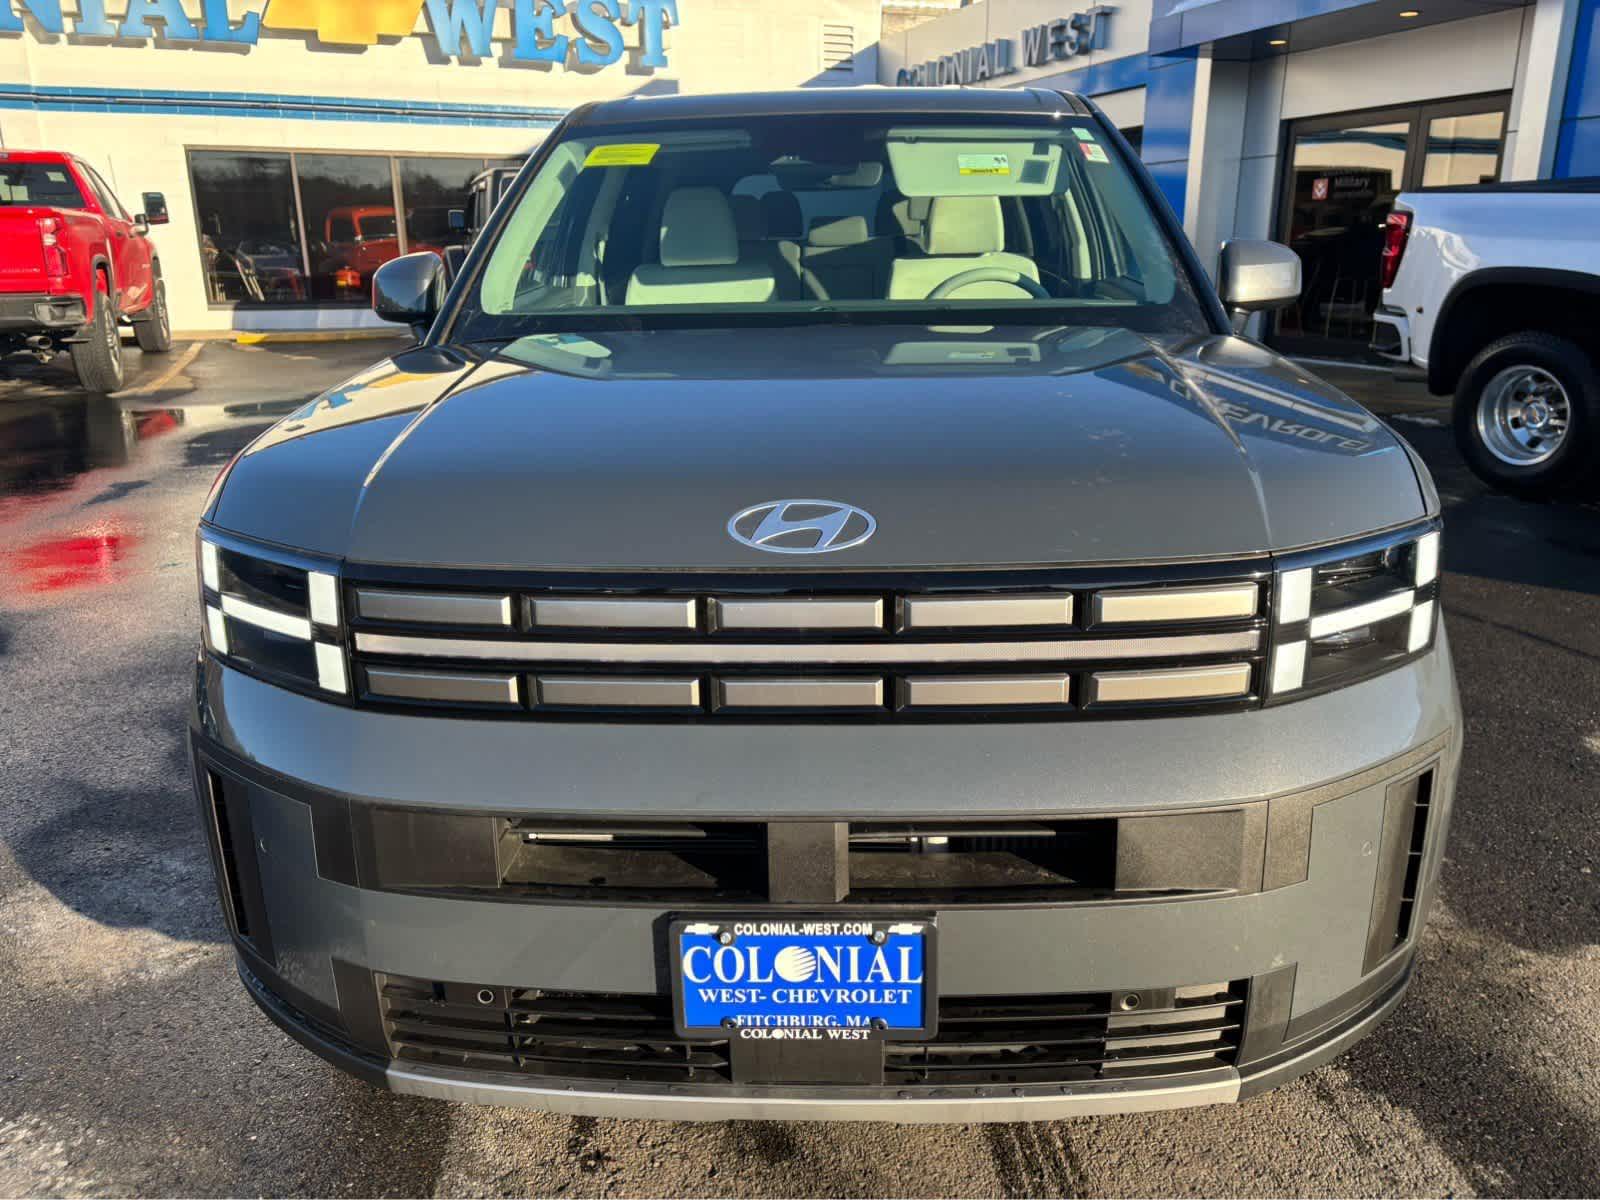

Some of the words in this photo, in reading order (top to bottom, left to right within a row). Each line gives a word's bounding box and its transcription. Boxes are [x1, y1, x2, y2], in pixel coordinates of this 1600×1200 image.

[424, 0, 679, 68] WEST
[896, 38, 1019, 88] COLONIAL
[1021, 5, 1120, 67] WEST
[734, 923, 873, 936] COLONIAL-WEST.COM
[682, 945, 923, 984] COLONIAL
[772, 988, 912, 1004] CHEVROLET
[846, 1015, 872, 1027] MA
[740, 1028, 823, 1040] COLONIAL
[828, 1028, 871, 1040] WEST
